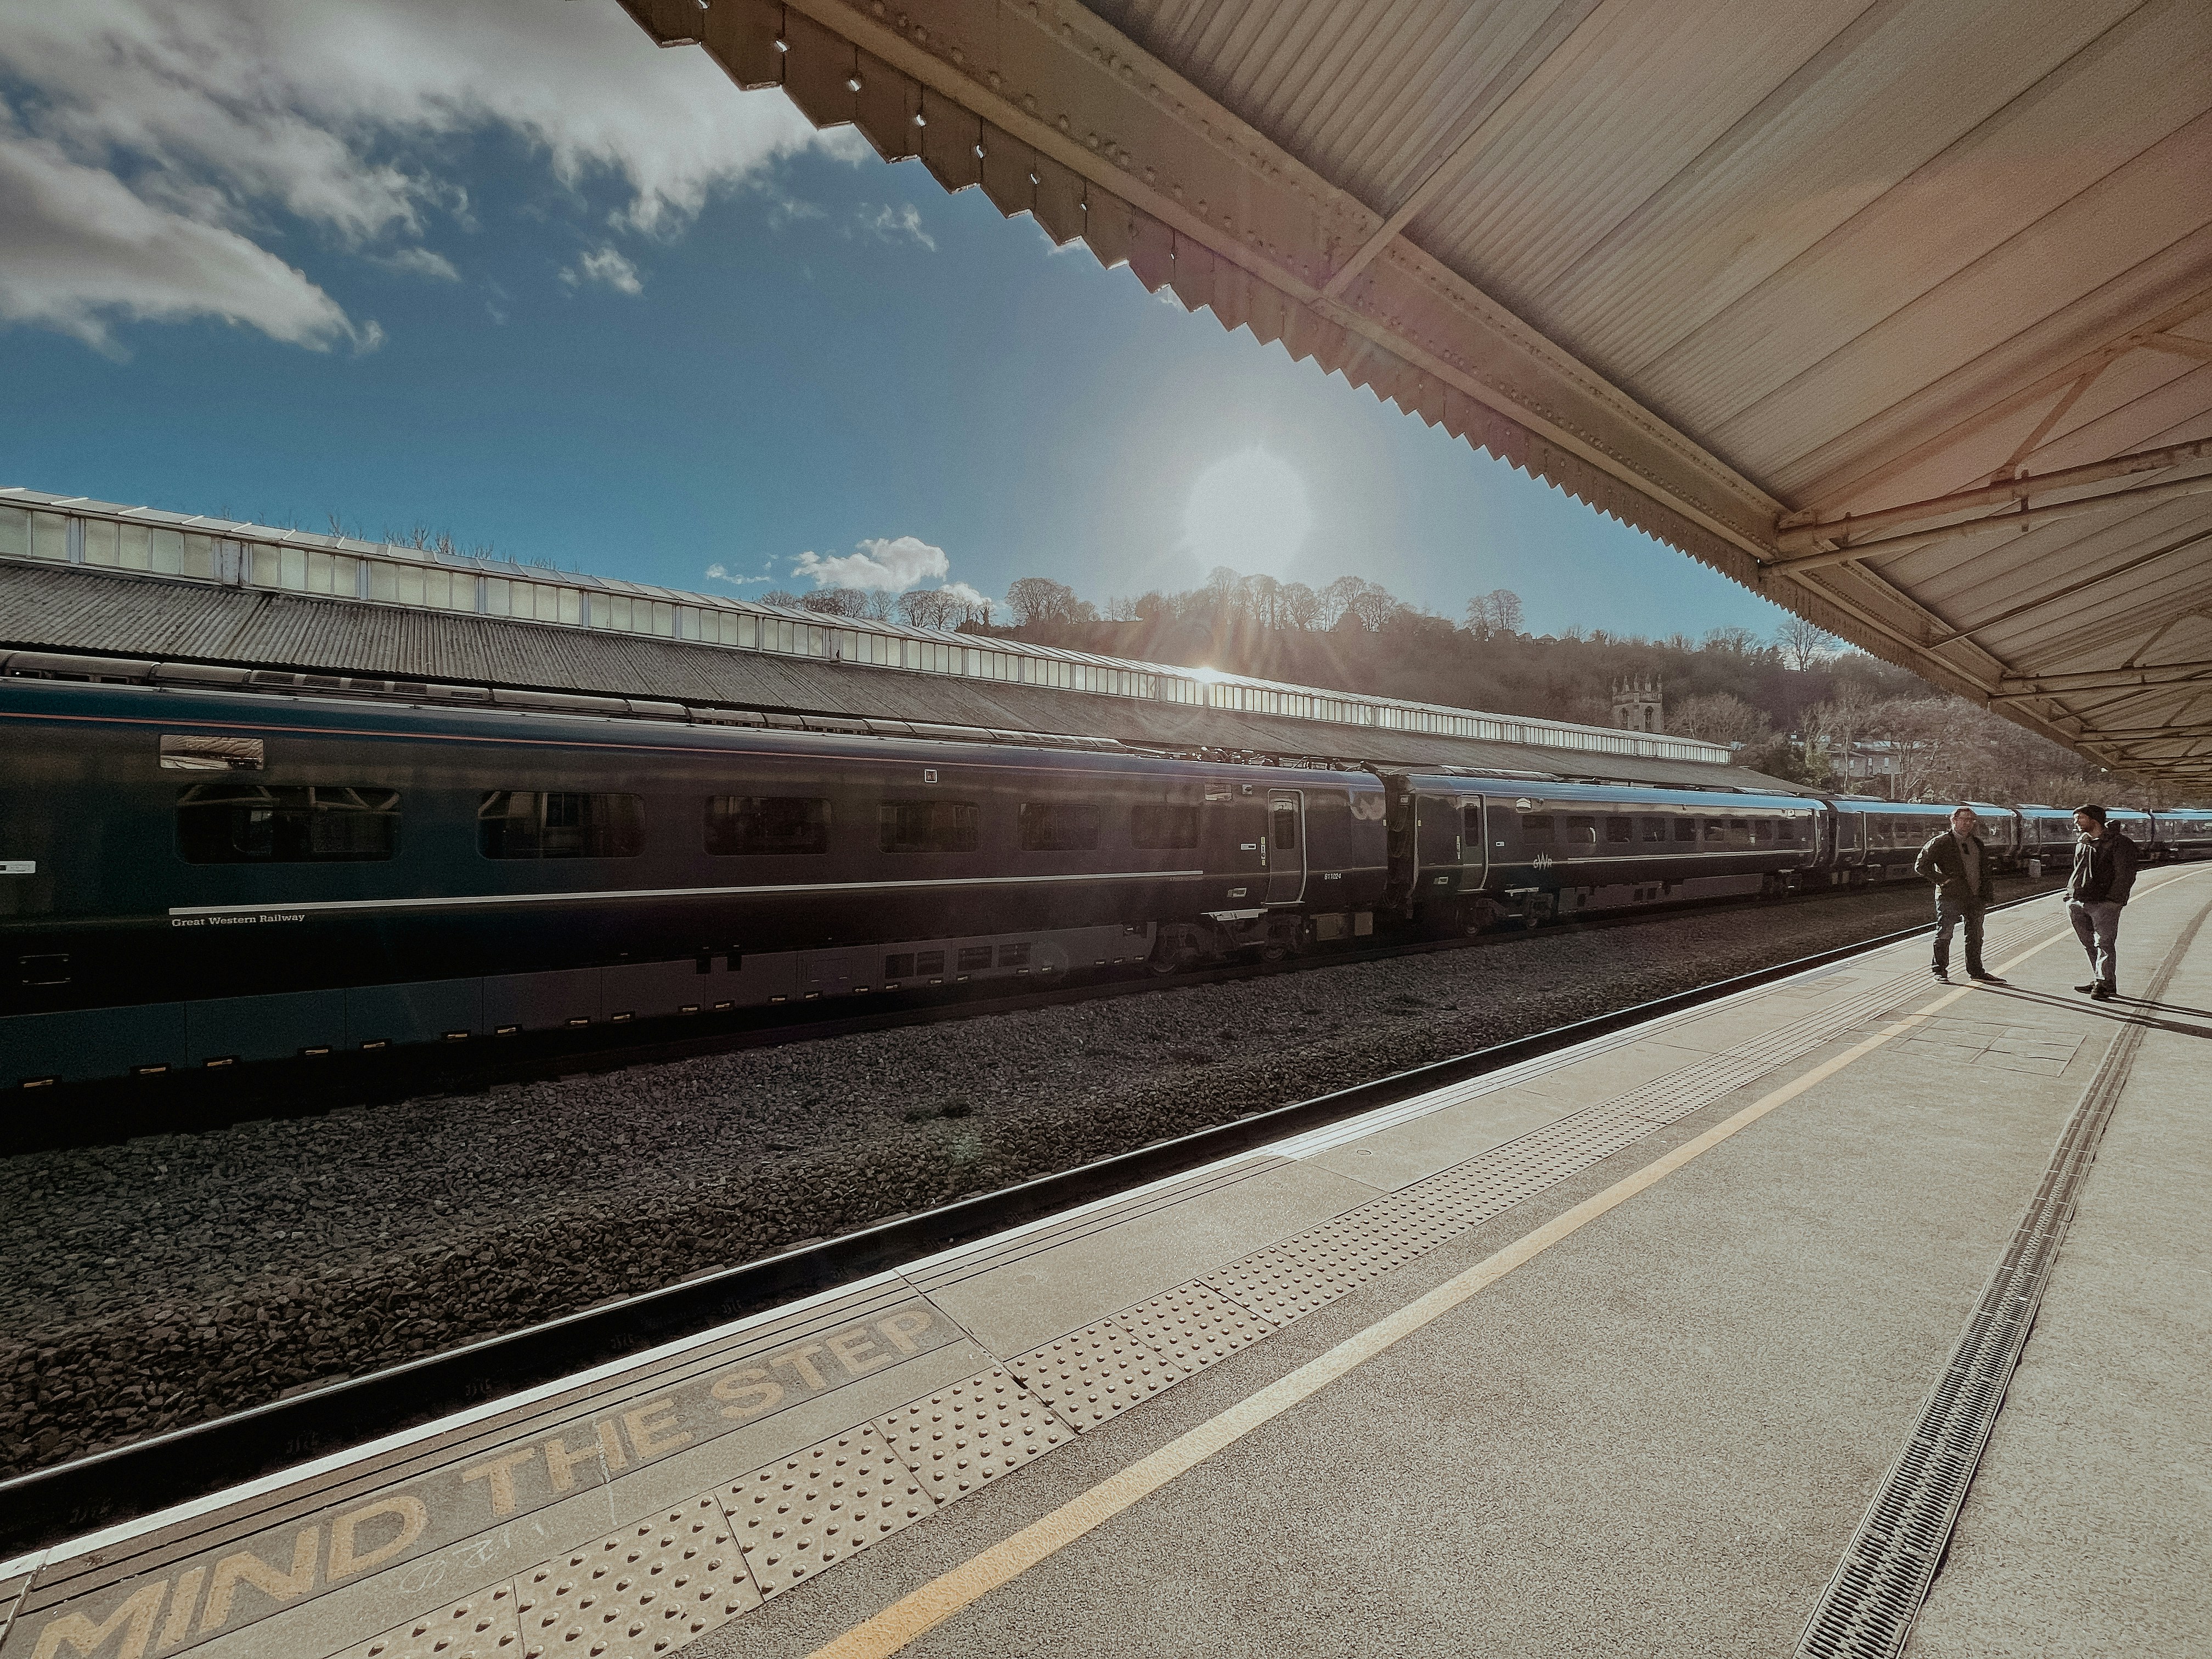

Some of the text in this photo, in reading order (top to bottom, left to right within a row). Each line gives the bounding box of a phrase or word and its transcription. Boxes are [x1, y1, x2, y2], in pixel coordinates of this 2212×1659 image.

[1533, 851, 1553, 871] GWR
[208, 916, 256, 925] Western
[259, 915, 305, 923] Railway
[31, 1496, 428, 1659] MIND
[461, 1398, 693, 1518] THE
[710, 1311, 932, 1418] STEP
